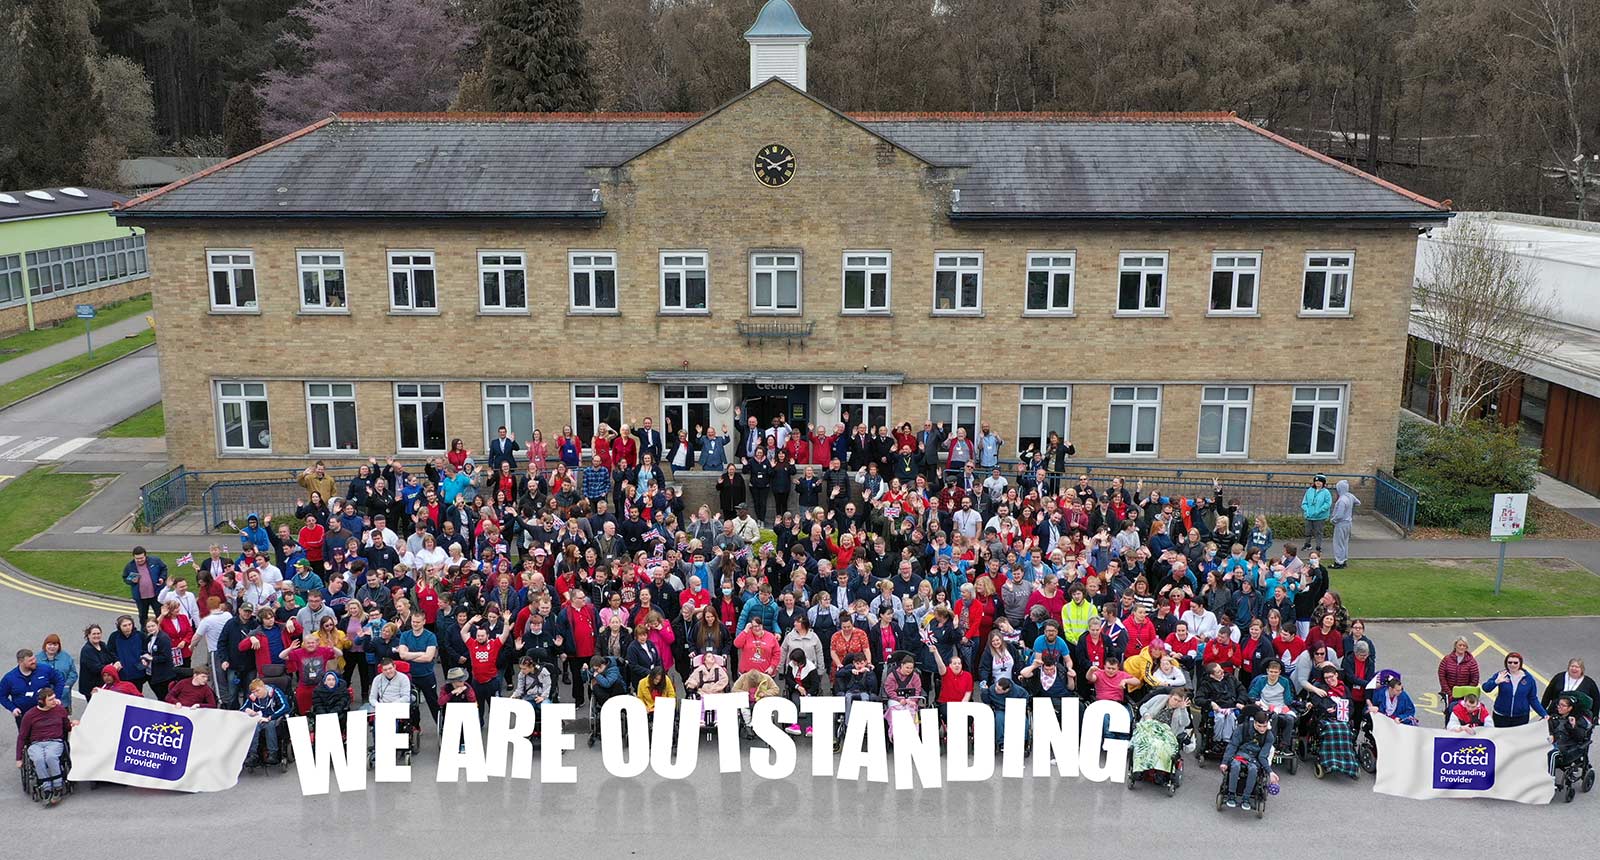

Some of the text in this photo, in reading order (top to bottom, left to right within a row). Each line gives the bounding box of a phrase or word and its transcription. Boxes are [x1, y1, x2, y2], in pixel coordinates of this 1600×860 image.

[129, 725, 184, 749] Ofsted
[124, 755, 161, 769] Provider
[126, 745, 178, 765] Outstanding
[1440, 751, 1489, 765] Ofsted
[1440, 768, 1487, 777] Outstanding
[1440, 775, 1473, 783] Provider
